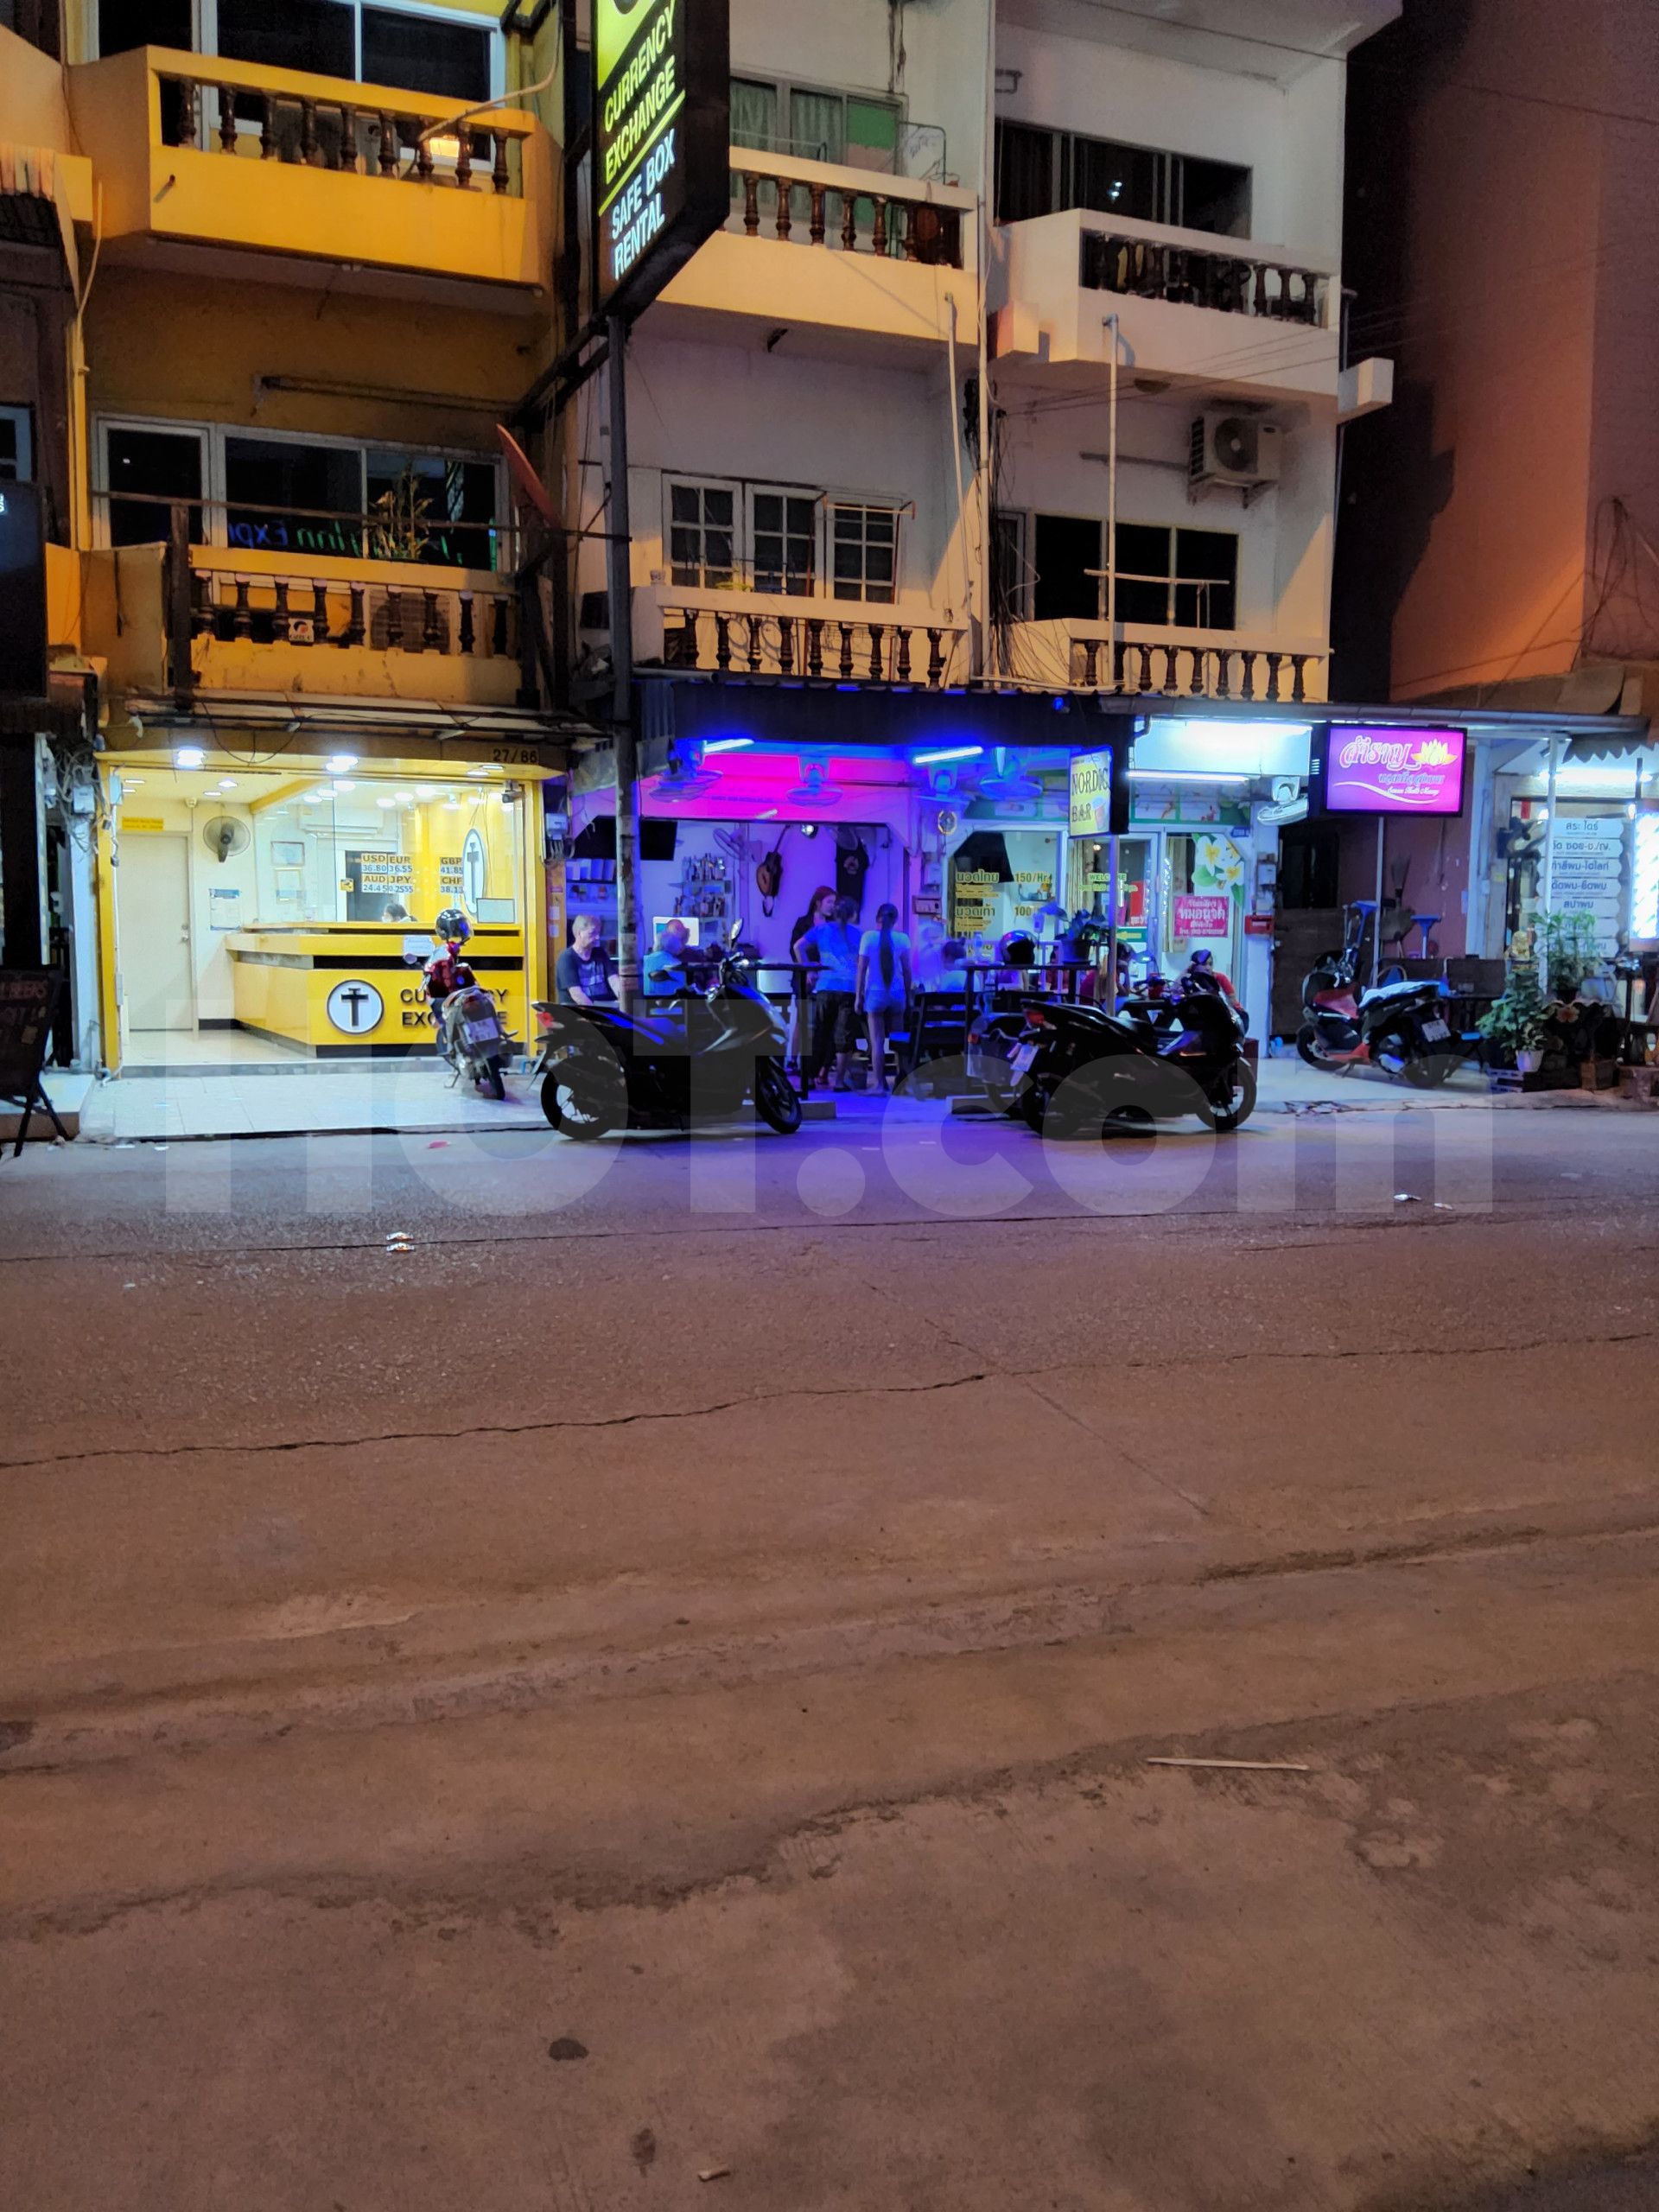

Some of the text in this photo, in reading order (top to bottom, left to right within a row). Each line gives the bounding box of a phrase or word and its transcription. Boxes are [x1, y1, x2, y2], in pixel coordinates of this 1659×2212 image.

[605, 0, 675, 132] CURRENCY
[606, 54, 675, 185] EXCHANGE
[612, 129, 675, 240] SAFE BOX
[613, 193, 664, 281] RENTAL
[493, 748, 537, 763] 27/86
[1071, 803, 1092, 823] BAR
[363, 855, 385, 863] USD
[441, 866, 463, 874] 41.85
